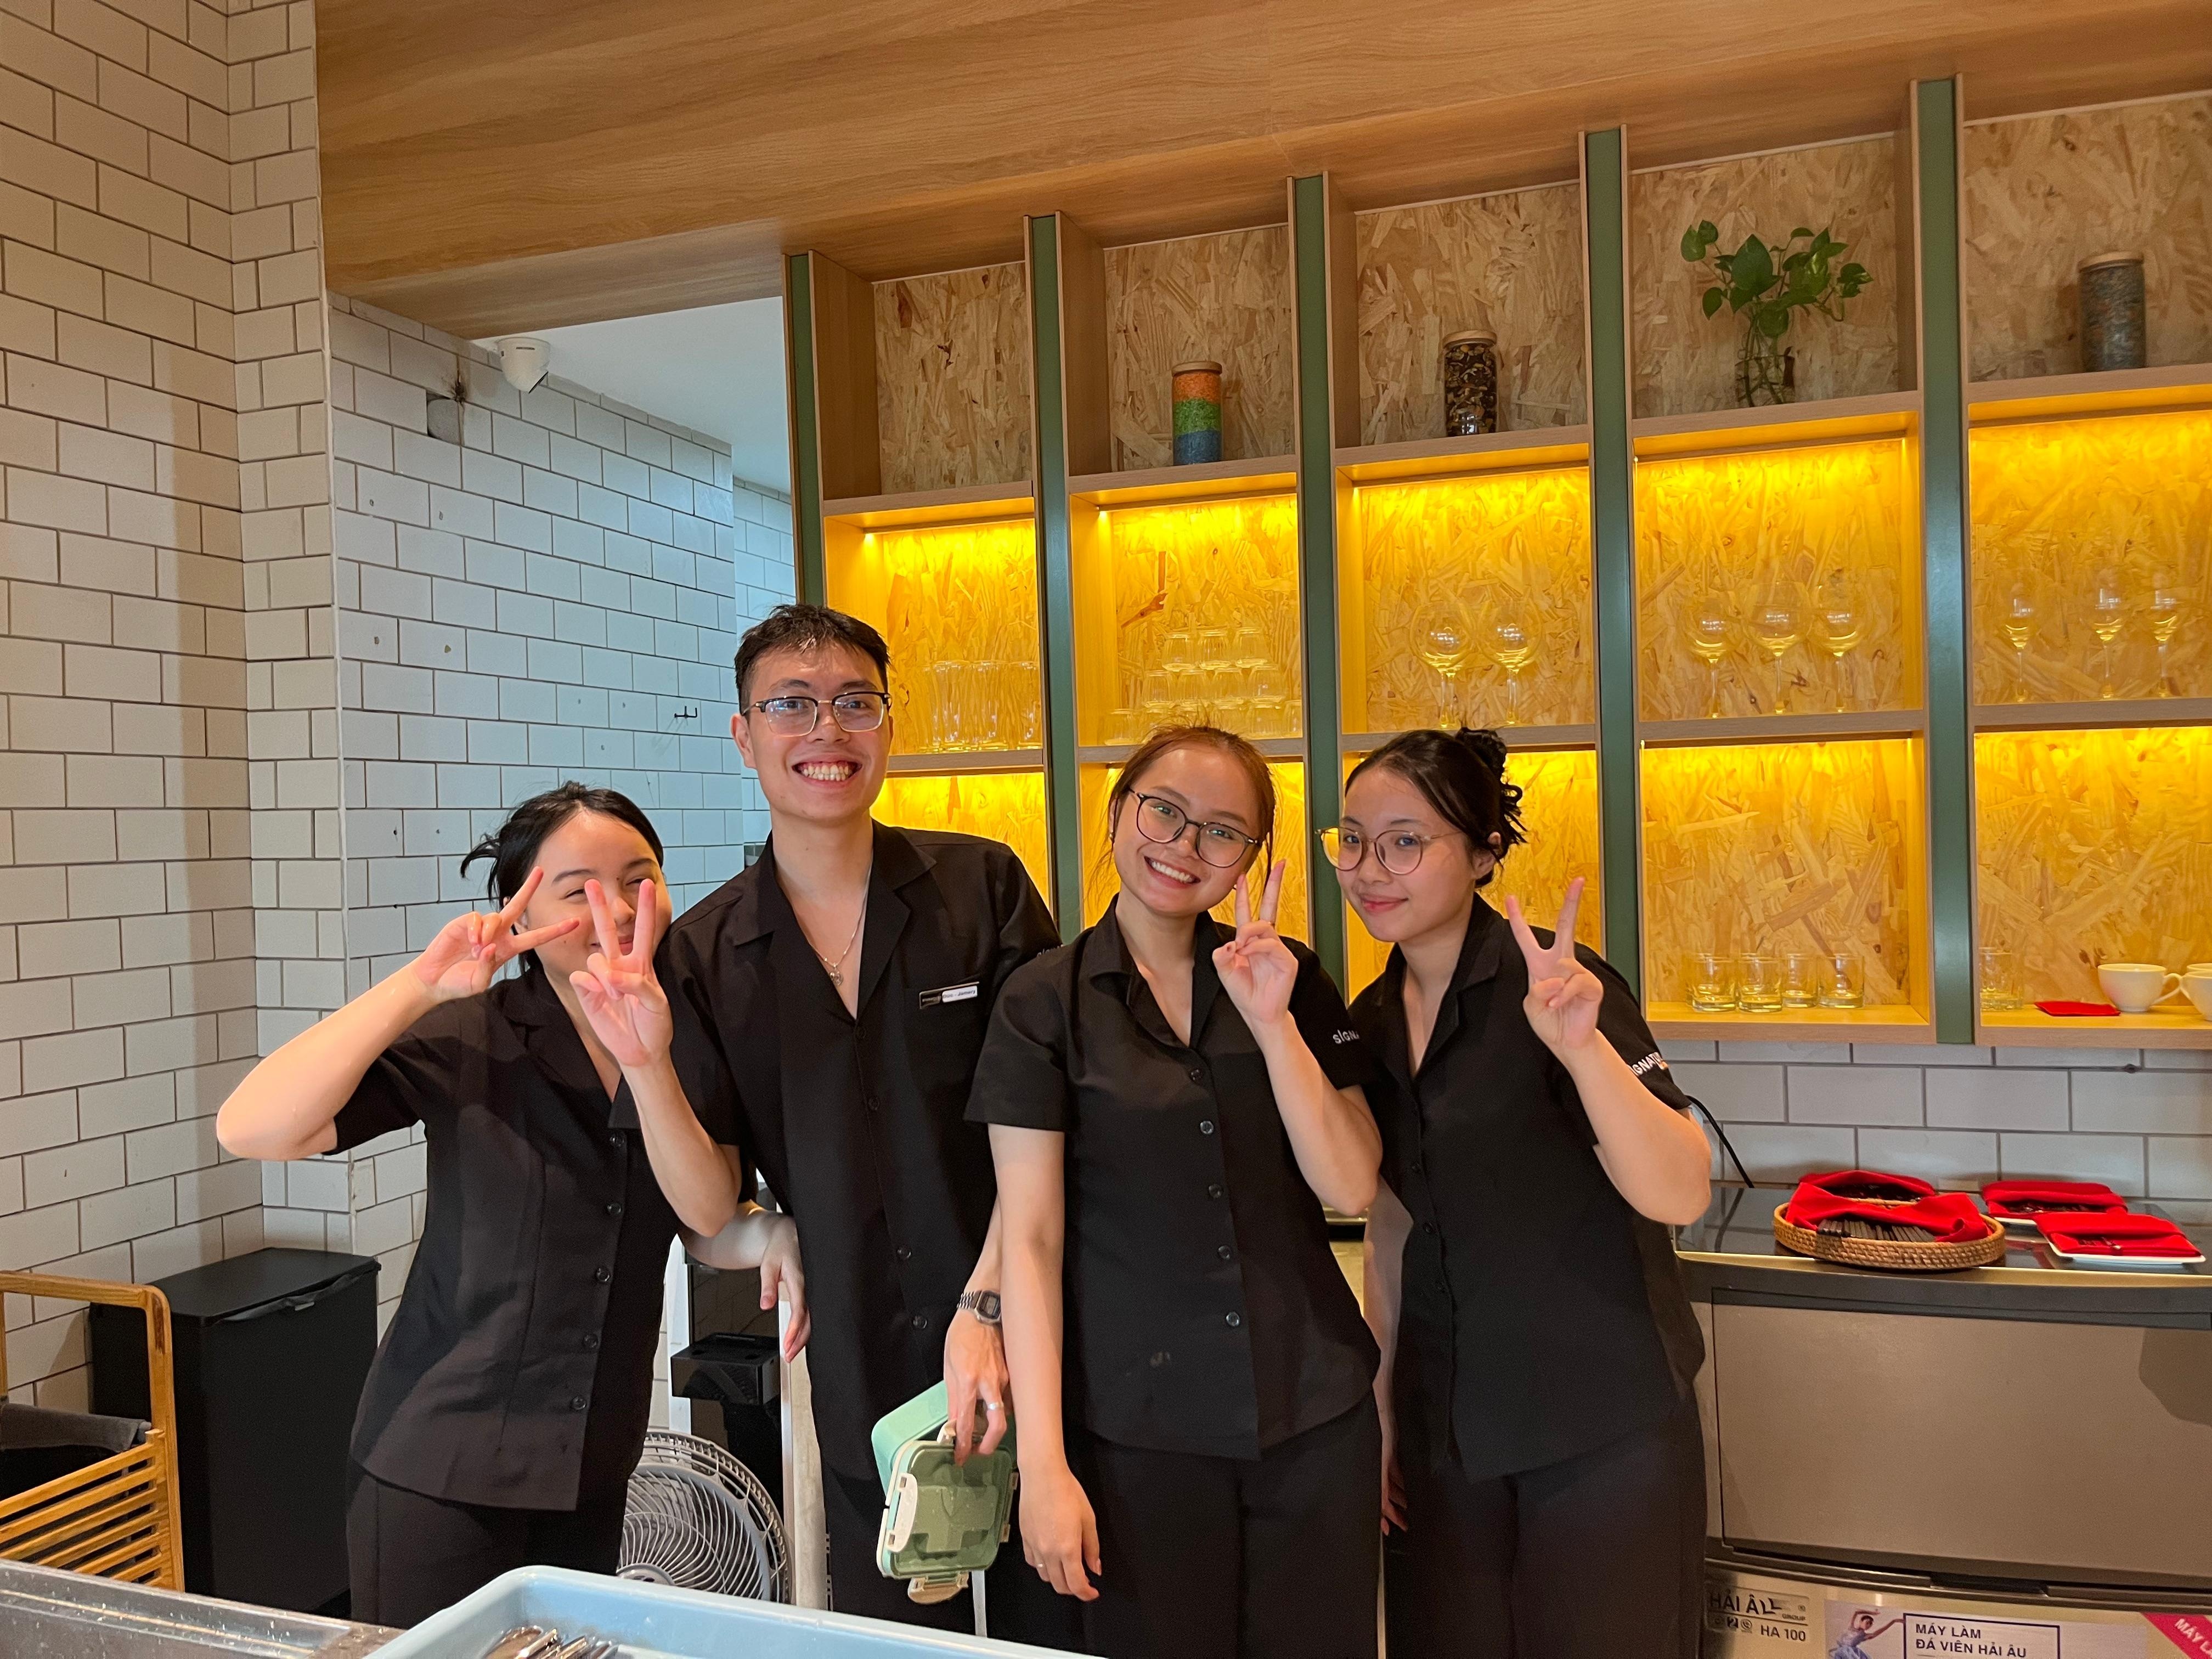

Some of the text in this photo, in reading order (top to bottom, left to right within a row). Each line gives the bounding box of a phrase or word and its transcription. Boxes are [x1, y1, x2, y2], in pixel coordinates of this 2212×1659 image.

[1760, 1625, 1806, 1641] HA 100
[1916, 1622, 1980, 1639] MÁY LÀM
[1916, 1637, 2026, 1658] ĐÁ VIÊN HẢI ÂU
